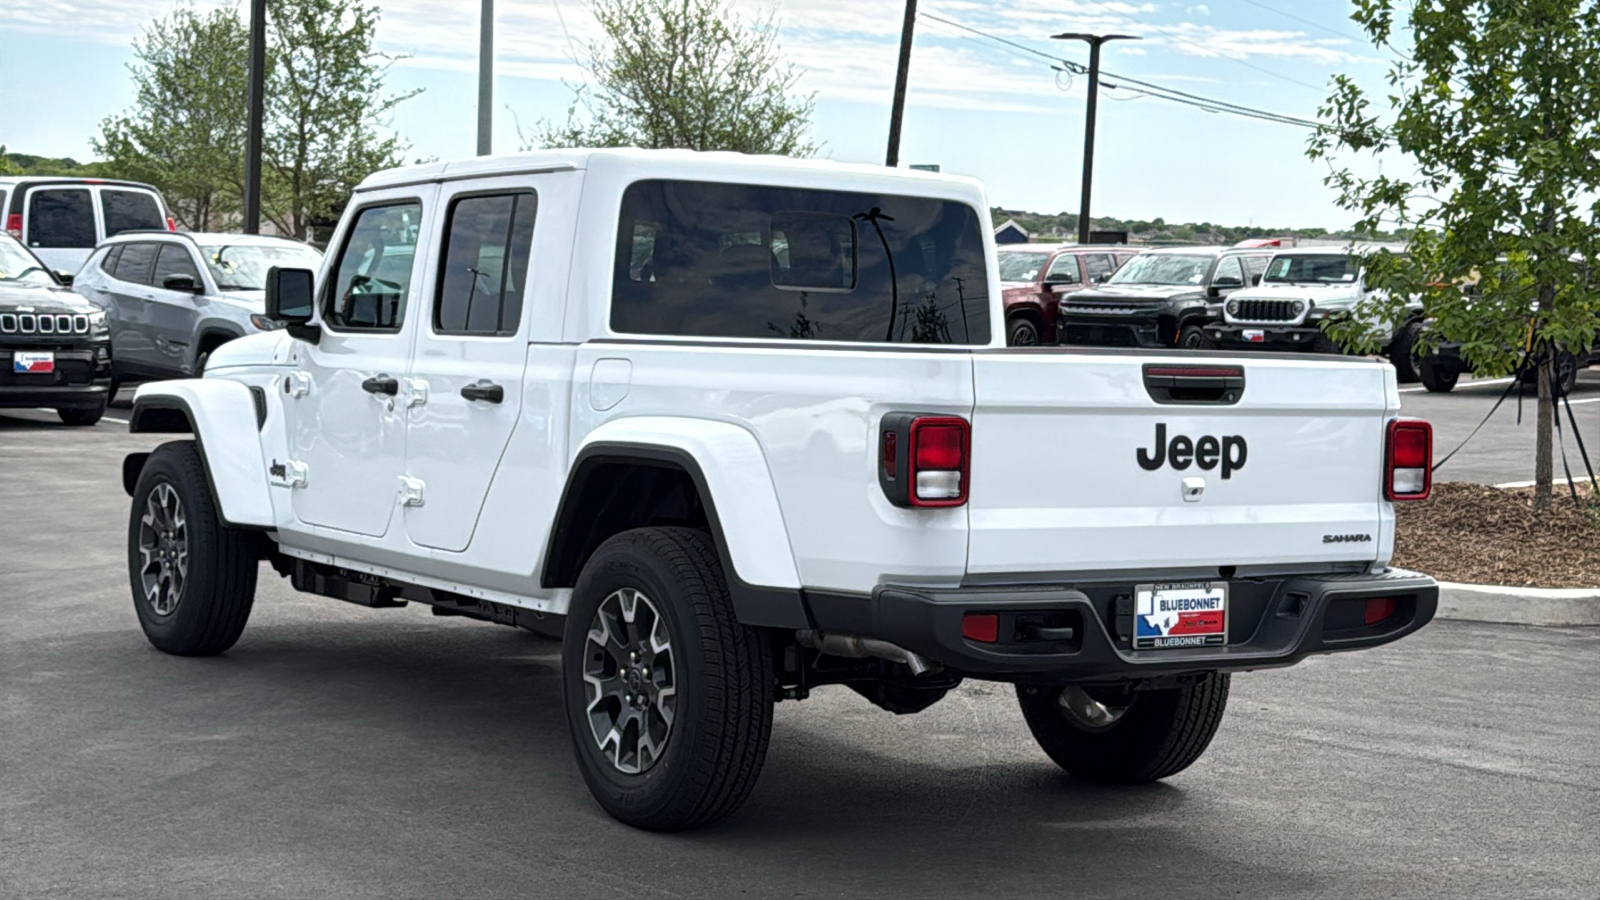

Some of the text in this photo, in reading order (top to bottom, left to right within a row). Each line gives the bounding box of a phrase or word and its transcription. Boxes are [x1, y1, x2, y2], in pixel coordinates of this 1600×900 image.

[1136, 423, 1248, 480] Jeep
[1322, 533, 1372, 543] SAHARA
[1160, 597, 1221, 611] BLUEBONNET
[1154, 637, 1206, 647] BLUEBONNET
